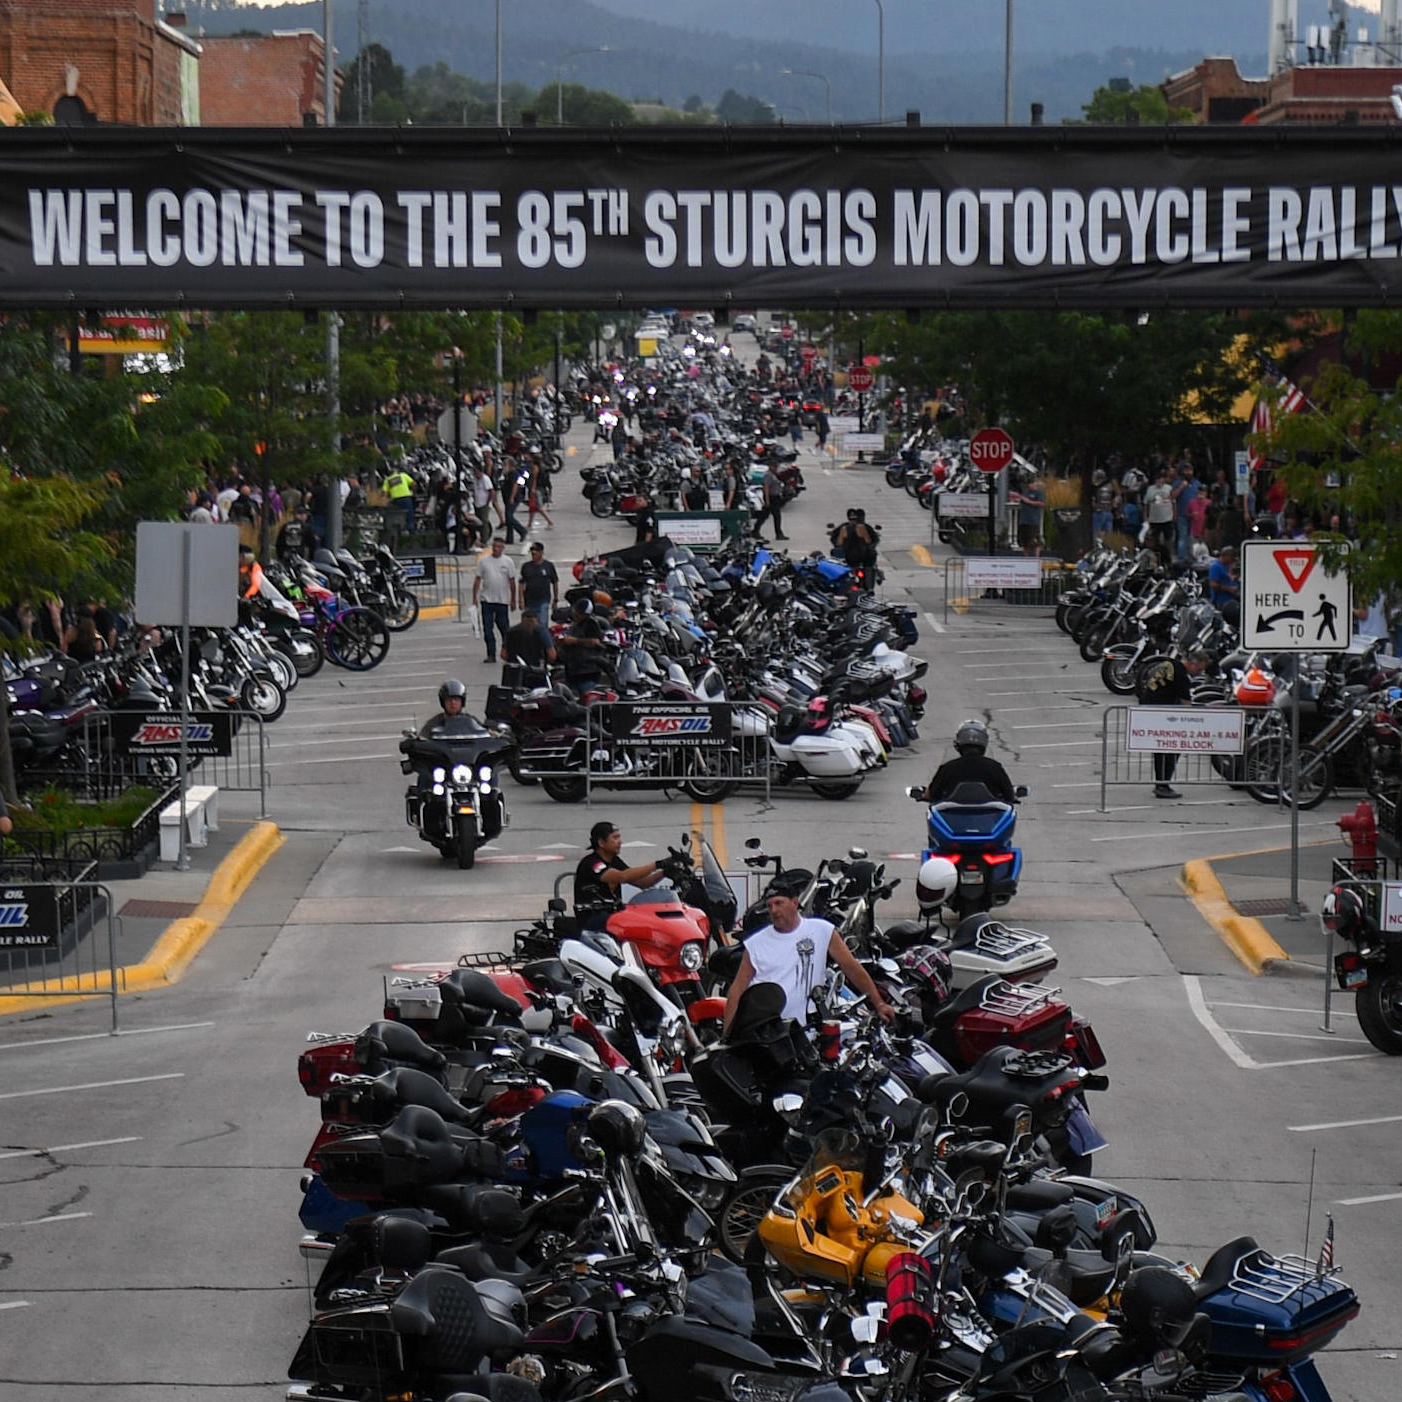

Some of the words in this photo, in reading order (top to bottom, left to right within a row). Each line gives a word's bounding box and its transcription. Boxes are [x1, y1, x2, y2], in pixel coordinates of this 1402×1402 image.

[28, 189, 304, 267] WELCOME
[317, 190, 387, 268] TO
[398, 191, 503, 268] THE
[517, 189, 629, 268] 85TH
[644, 189, 879, 268] STURGIS
[893, 187, 1253, 267] MOTORCYCLE
[850, 374, 871, 384] STOP
[972, 441, 1010, 458] STOP
[1255, 593, 1290, 607] HERE
[1289, 624, 1305, 638] TO
[635, 718, 711, 734] AMSOIL
[1132, 729, 1146, 737] NO
[1147, 730, 1187, 739] PARKING
[1157, 740, 1178, 748] THIS
[1180, 741, 1214, 749] BLOCK
[4, 889, 25, 900] OIL
[15, 935, 51, 945] RALLY
